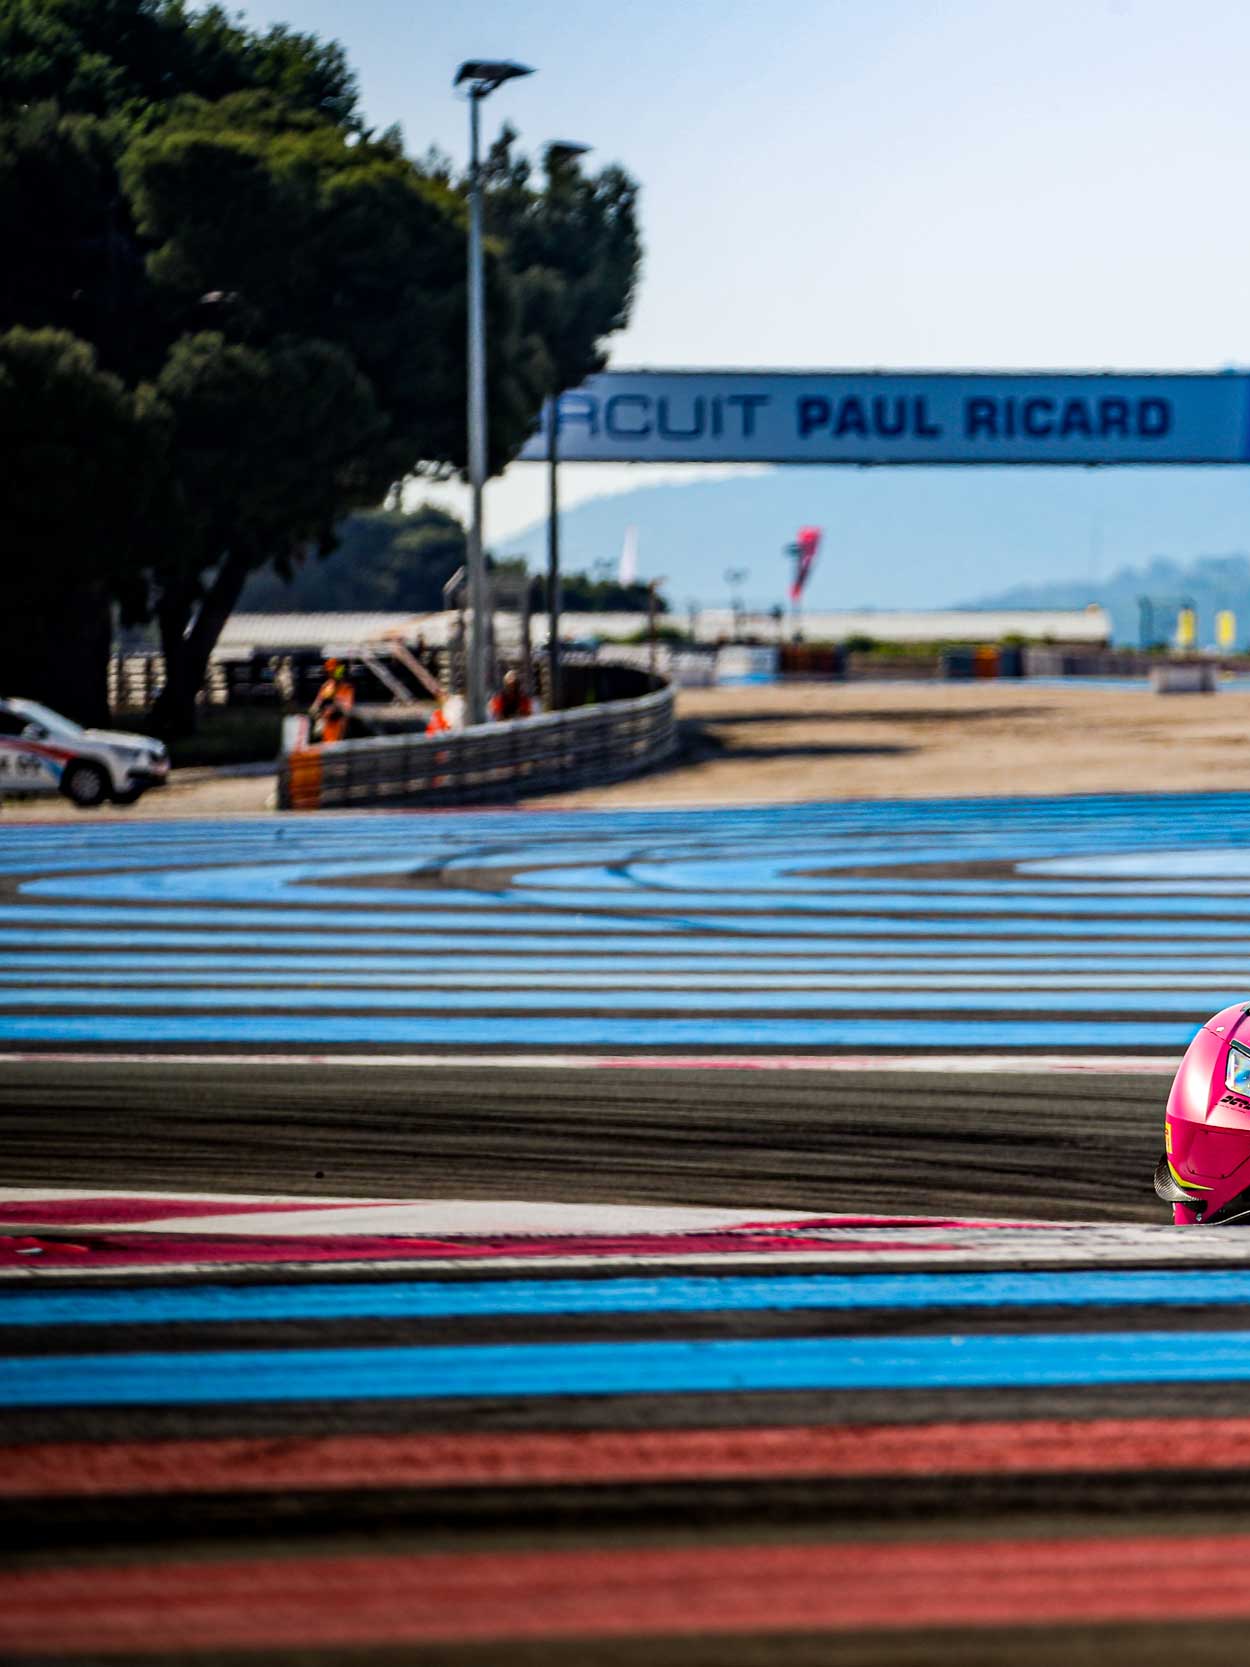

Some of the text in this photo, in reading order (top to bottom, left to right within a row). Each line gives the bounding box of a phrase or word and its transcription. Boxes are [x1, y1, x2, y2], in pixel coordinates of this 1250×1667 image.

[540, 393, 1171, 441] RCUIT PAUL RICARD
